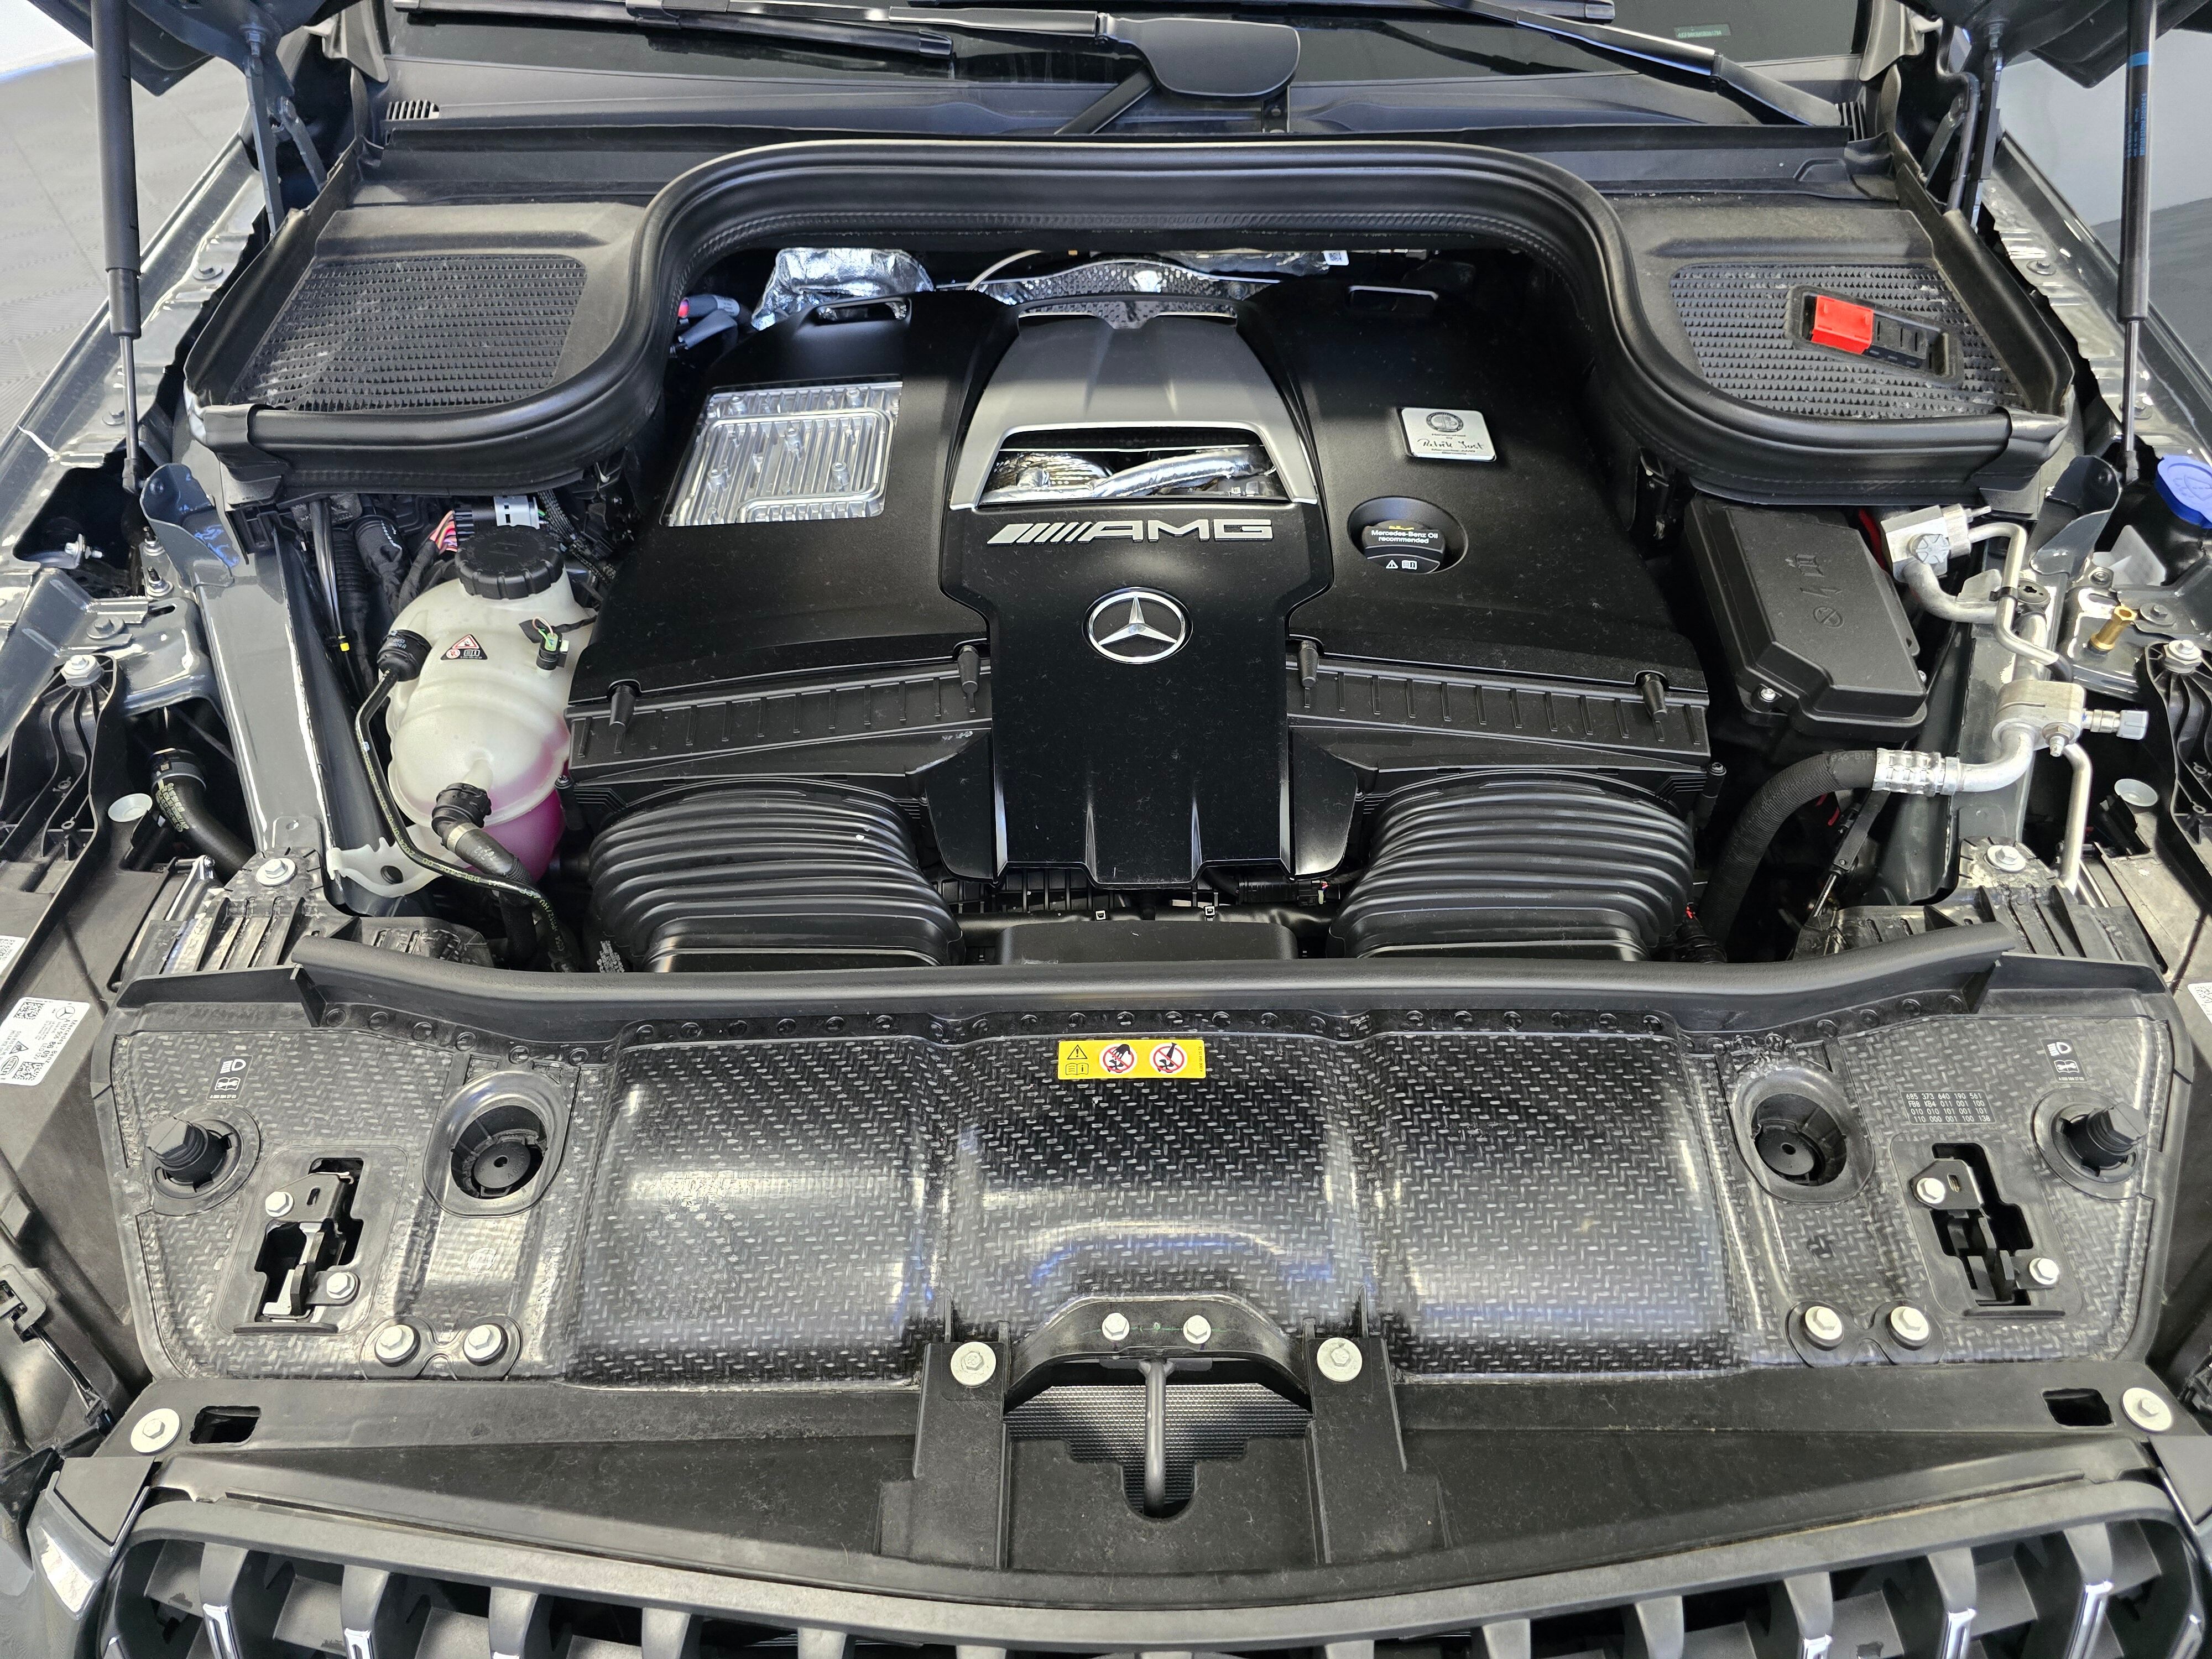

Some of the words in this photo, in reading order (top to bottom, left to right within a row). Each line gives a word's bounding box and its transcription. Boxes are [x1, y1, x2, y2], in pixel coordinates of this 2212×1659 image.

[1078, 519, 1274, 542] AMG
[58, 1019, 78, 1045] Mercedes
[45, 1050, 58, 1063] Benz
